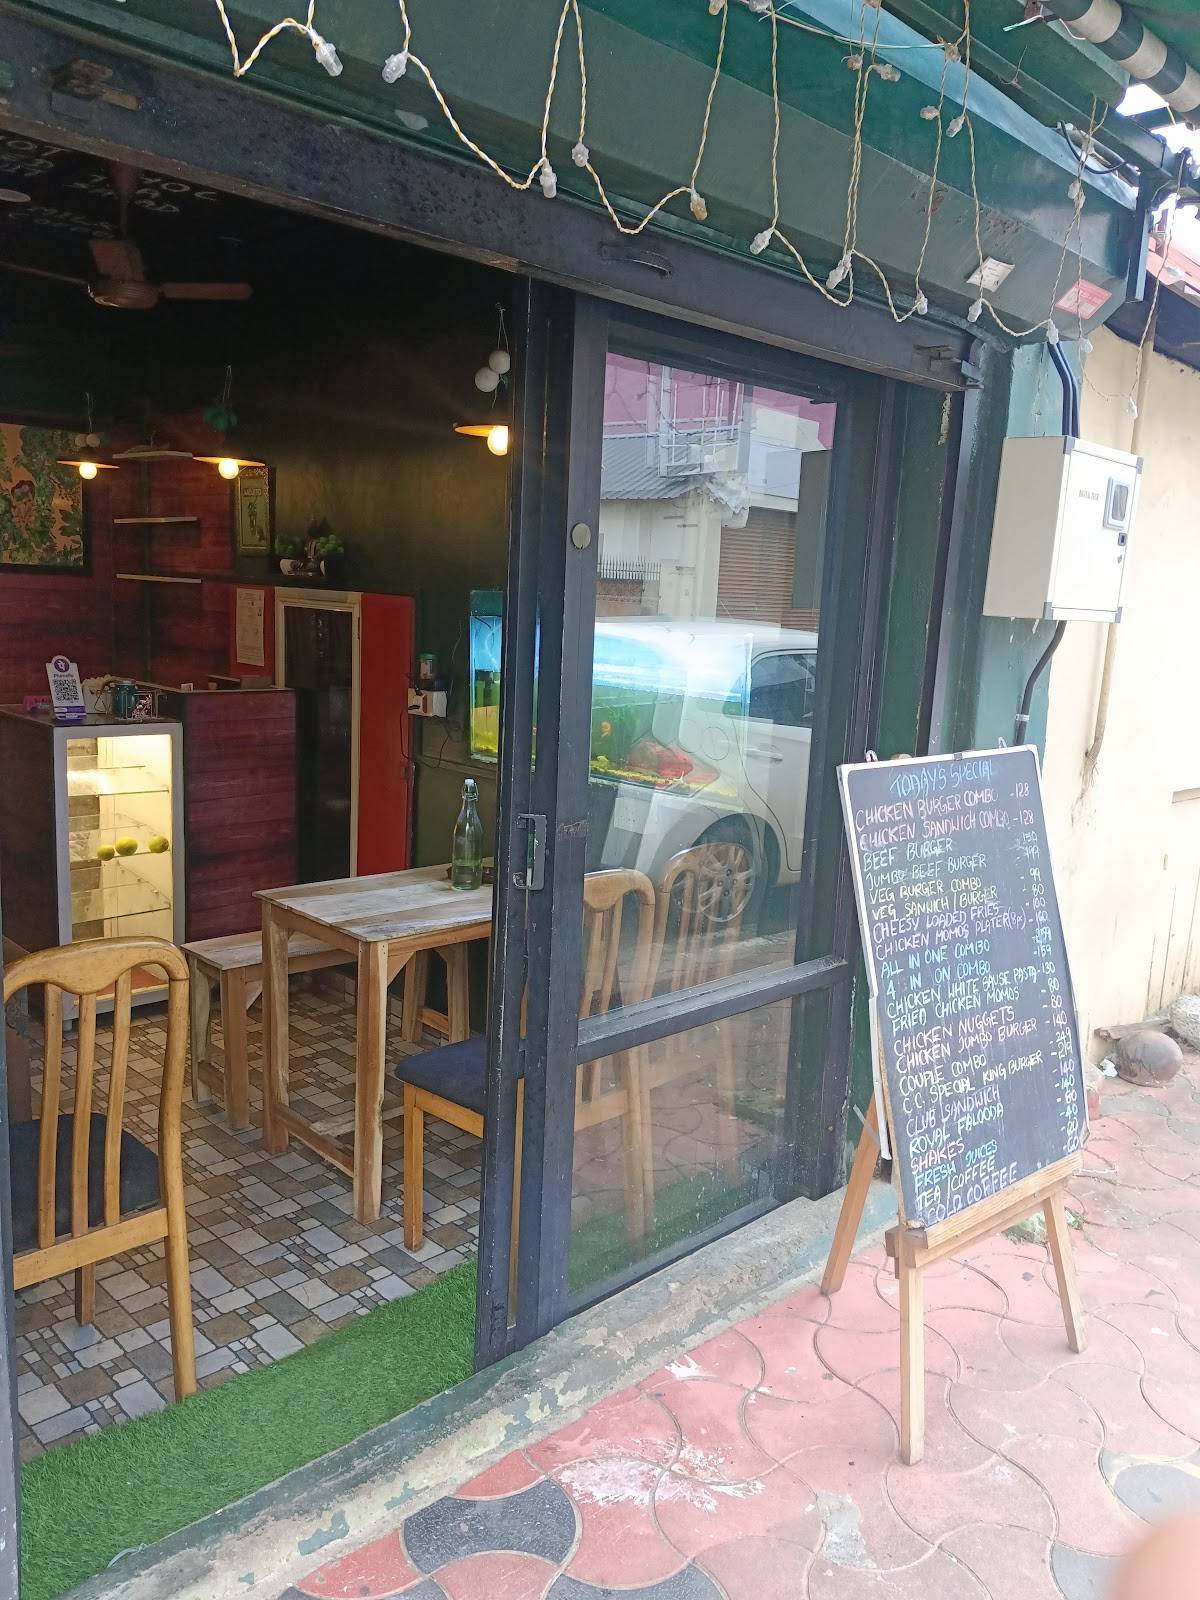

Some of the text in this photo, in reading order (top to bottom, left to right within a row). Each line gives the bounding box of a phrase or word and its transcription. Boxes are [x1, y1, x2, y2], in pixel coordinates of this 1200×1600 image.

[950, 759, 993, 788] SPECIAL
[855, 800, 915, 833] CHICKEN
[917, 794, 962, 819] BURGER
[963, 788, 998, 806] COMBO
[859, 822, 916, 851] CHICKEN
[921, 811, 976, 839] SANDWICH
[979, 809, 1009, 829] COMBO
[863, 847, 897, 872] BEEF
[906, 838, 953, 861] BURGER
[865, 869, 906, 891] JUMBO
[912, 860, 943, 879] BEEF
[947, 853, 987, 873] BURGER
[869, 887, 896, 904] VEG
[900, 879, 944, 901] BURGER
[950, 877, 982, 892] COMBO
[872, 904, 899, 920] VEG
[960, 885, 998, 908] BURGER
[873, 916, 920, 943] CHEESY
[926, 910, 967, 929] LOADED
[970, 902, 999, 920] FRIES
[875, 931, 930, 960] CHICKEN
[935, 923, 969, 945] MOMOS
[881, 960, 905, 979] ALL
[908, 952, 921, 970] IN
[924, 944, 948, 964] ONE
[954, 938, 990, 959] COMBO
[886, 979, 897, 1000] 4
[909, 972, 922, 990] IN
[934, 965, 951, 983] ON
[957, 960, 991, 979] COMBO
[887, 986, 942, 1019] CHICKEN
[948, 978, 980, 998] WHITE
[982, 970, 1011, 992] SAUSE
[1012, 965, 1037, 985] PASTA
[891, 1008, 927, 1037] FRIED
[935, 993, 981, 1018] CHICKEN
[986, 986, 1020, 1004] MOMOS
[894, 1023, 953, 1057] CHICKEN
[959, 1006, 1014, 1036] NUGGETS
[896, 1042, 951, 1074] CHICKEN
[958, 1031, 993, 1053] JUMBO
[998, 1017, 1037, 1041] BURGER
[899, 1064, 945, 1097] COUPLE
[951, 1053, 987, 1078] COMBO
[929, 1076, 975, 1103] SPECIAL
[982, 1063, 1007, 1085] KING
[1008, 1050, 1044, 1074] BURGER
[906, 1108, 937, 1137] CLUB
[941, 1082, 1000, 1121] SANDWICH
[958, 1103, 1004, 1136] FALOODA
[911, 1137, 965, 1175] SHAKES
[915, 1160, 956, 1194] FRESH
[965, 1138, 998, 1168] JUICES
[916, 1184, 941, 1211] TEA
[928, 1194, 961, 1220] COLD
[967, 1161, 1017, 1204] COFFEE
